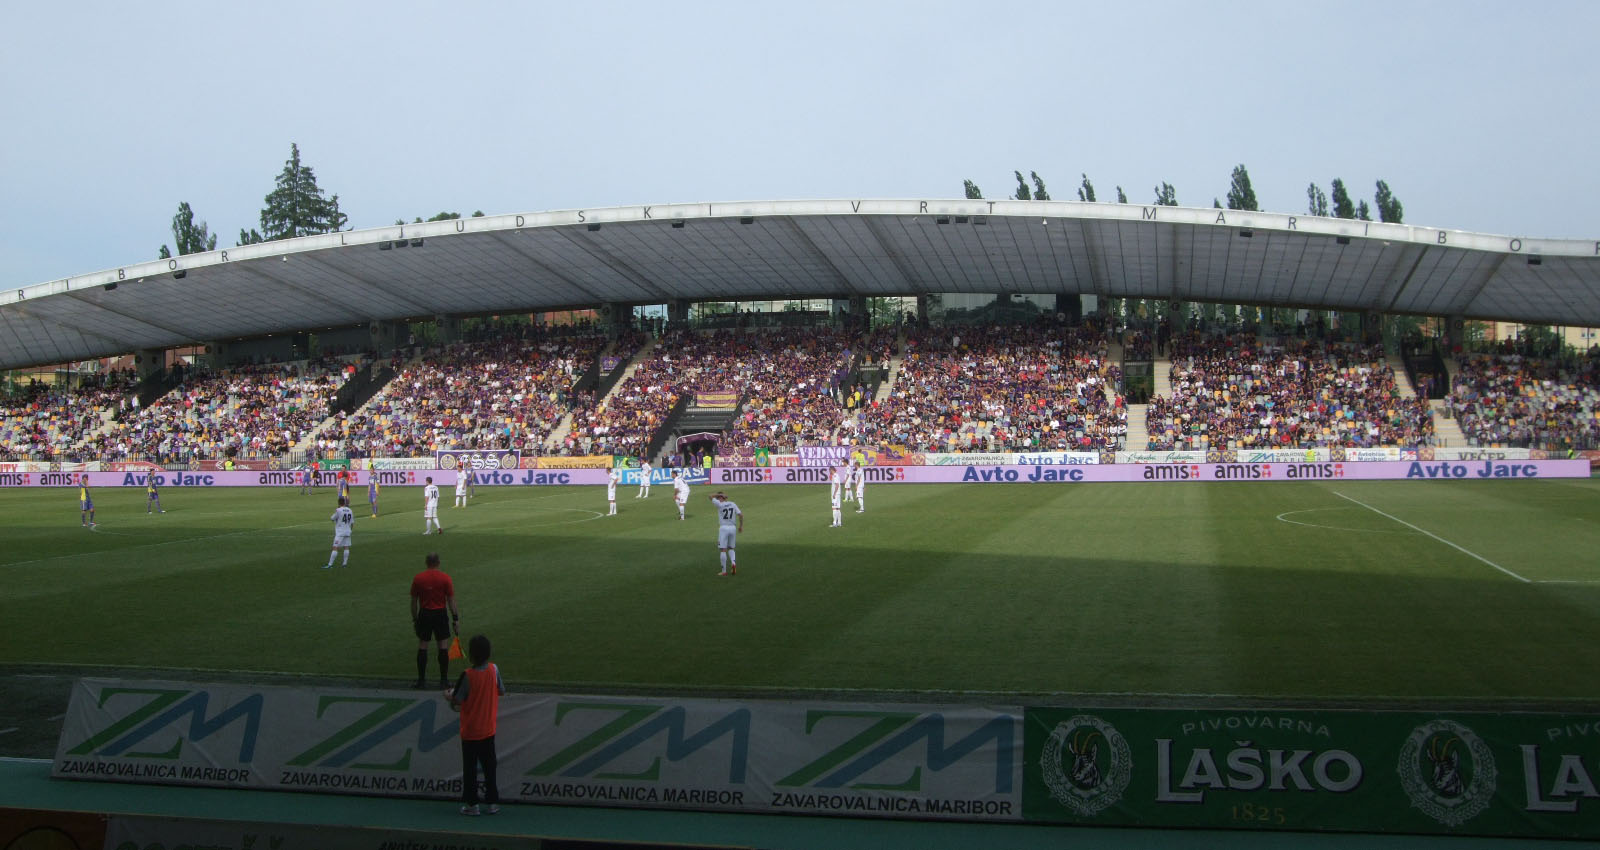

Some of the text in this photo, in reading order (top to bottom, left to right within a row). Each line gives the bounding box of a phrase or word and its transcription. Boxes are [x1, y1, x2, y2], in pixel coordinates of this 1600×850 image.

[341, 204, 713, 245] LJUDSKI
[850, 201, 993, 214] VRT
[800, 447, 846, 458] VEDNO
[1018, 454, 1094, 465] Avto Jarc
[378, 471, 407, 485] mis
[466, 470, 571, 485] Avto Jarc
[721, 468, 763, 482] amis
[786, 468, 828, 482] amis
[963, 464, 1084, 482] Avto Jarc
[1143, 465, 1190, 479] amis
[1214, 464, 1262, 479] amis
[1286, 463, 1334, 478] amis
[1407, 461, 1538, 478] Avto Jarc
[40, 473, 73, 486] amis
[122, 472, 214, 486] Avo Jarc
[259, 472, 295, 485] amis
[722, 507, 735, 520] 27
[66, 687, 264, 763] ZM
[1181, 716, 1332, 738] PIVOVARNA
[523, 702, 752, 784] ZM
[774, 709, 1014, 794] ZM
[60, 760, 250, 783] ZAVAROVALNICA MARIBOR
[1155, 739, 1364, 804] LAŠKO
[1519, 744, 1600, 812] LA
[280, 770, 488, 798] ZAVAROVALNICA MARIBR
[519, 781, 744, 806] ZAVAROVALNICA MARIBOR
[771, 791, 1013, 816] ZAVAROVALNICA MARIBOR
[1231, 804, 1287, 826] 1825
